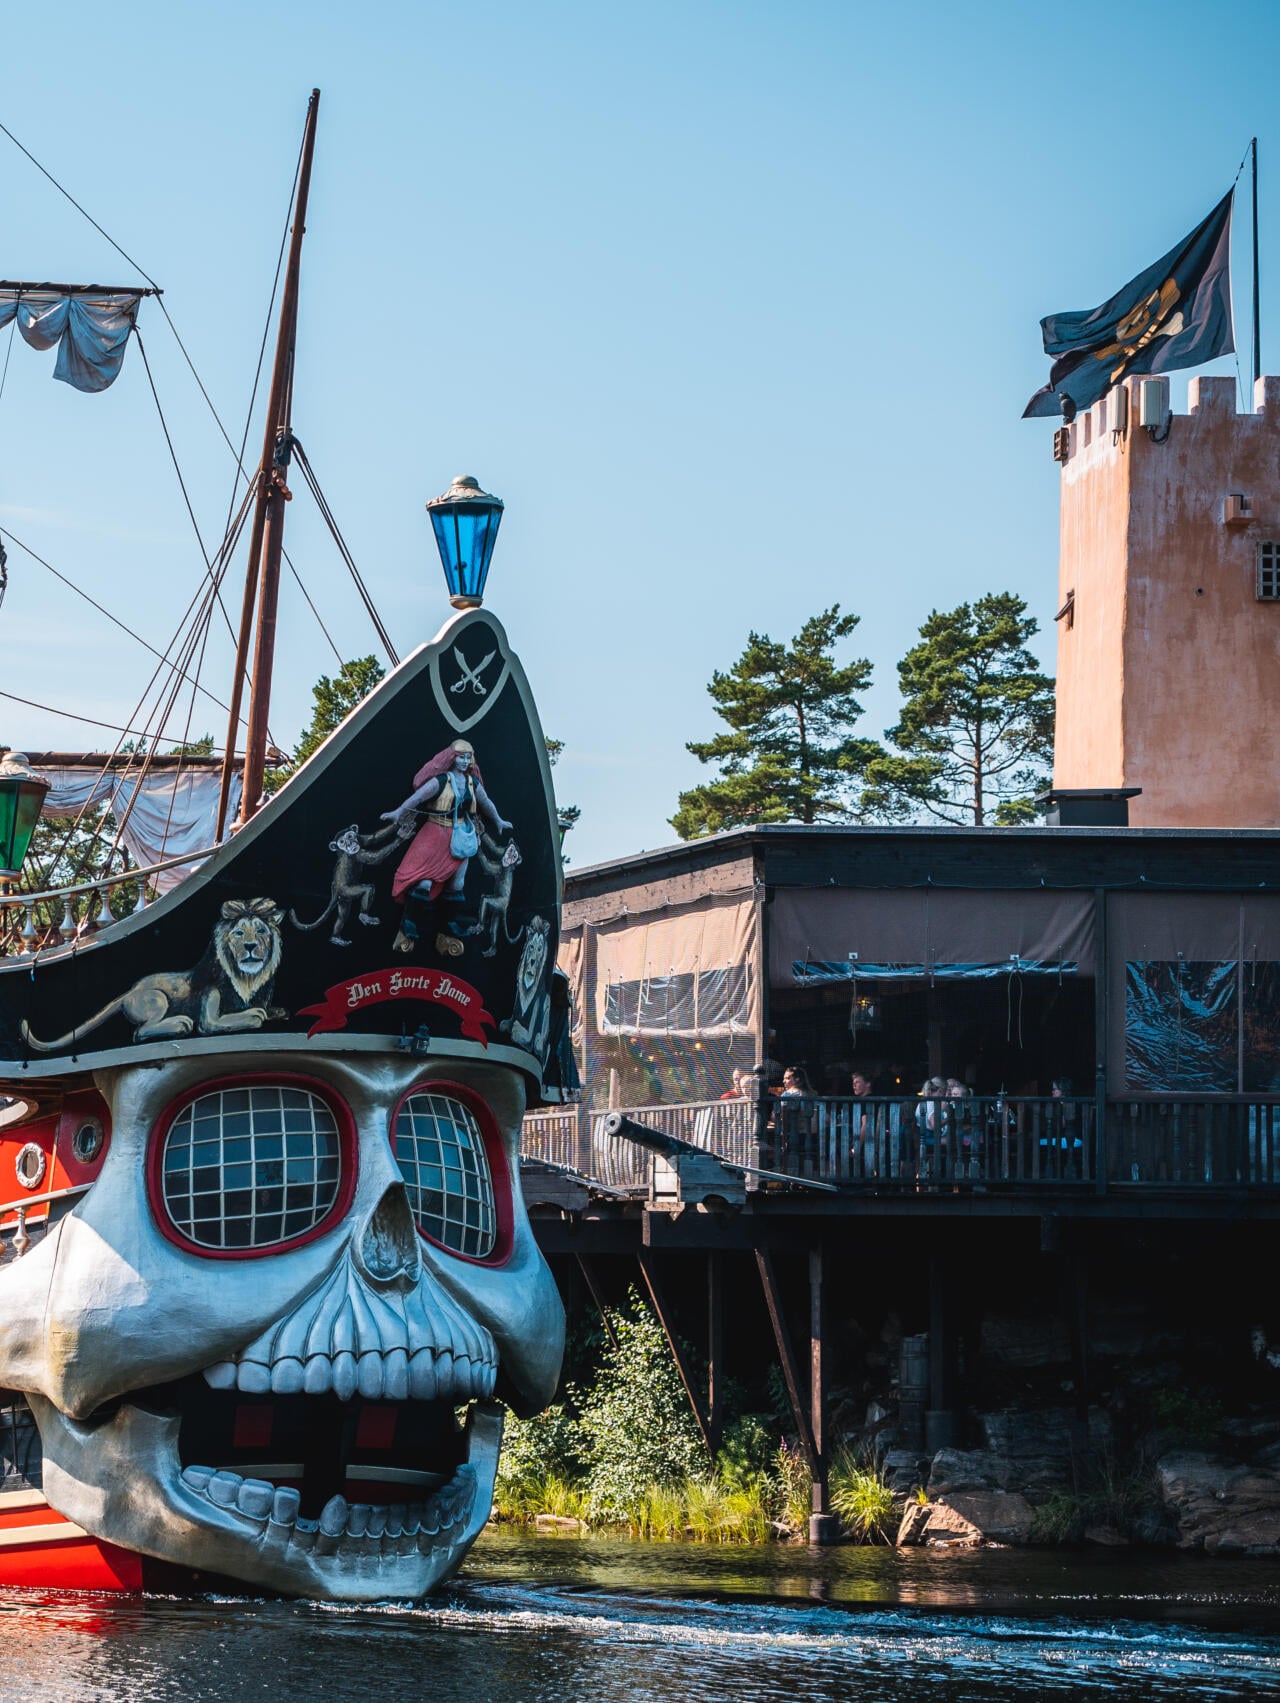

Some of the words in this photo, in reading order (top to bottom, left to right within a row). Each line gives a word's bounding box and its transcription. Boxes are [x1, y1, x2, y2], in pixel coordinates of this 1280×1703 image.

[346, 982, 382, 1007] Den
[389, 972, 431, 996] Sorte
[432, 976, 471, 1006] Dame
